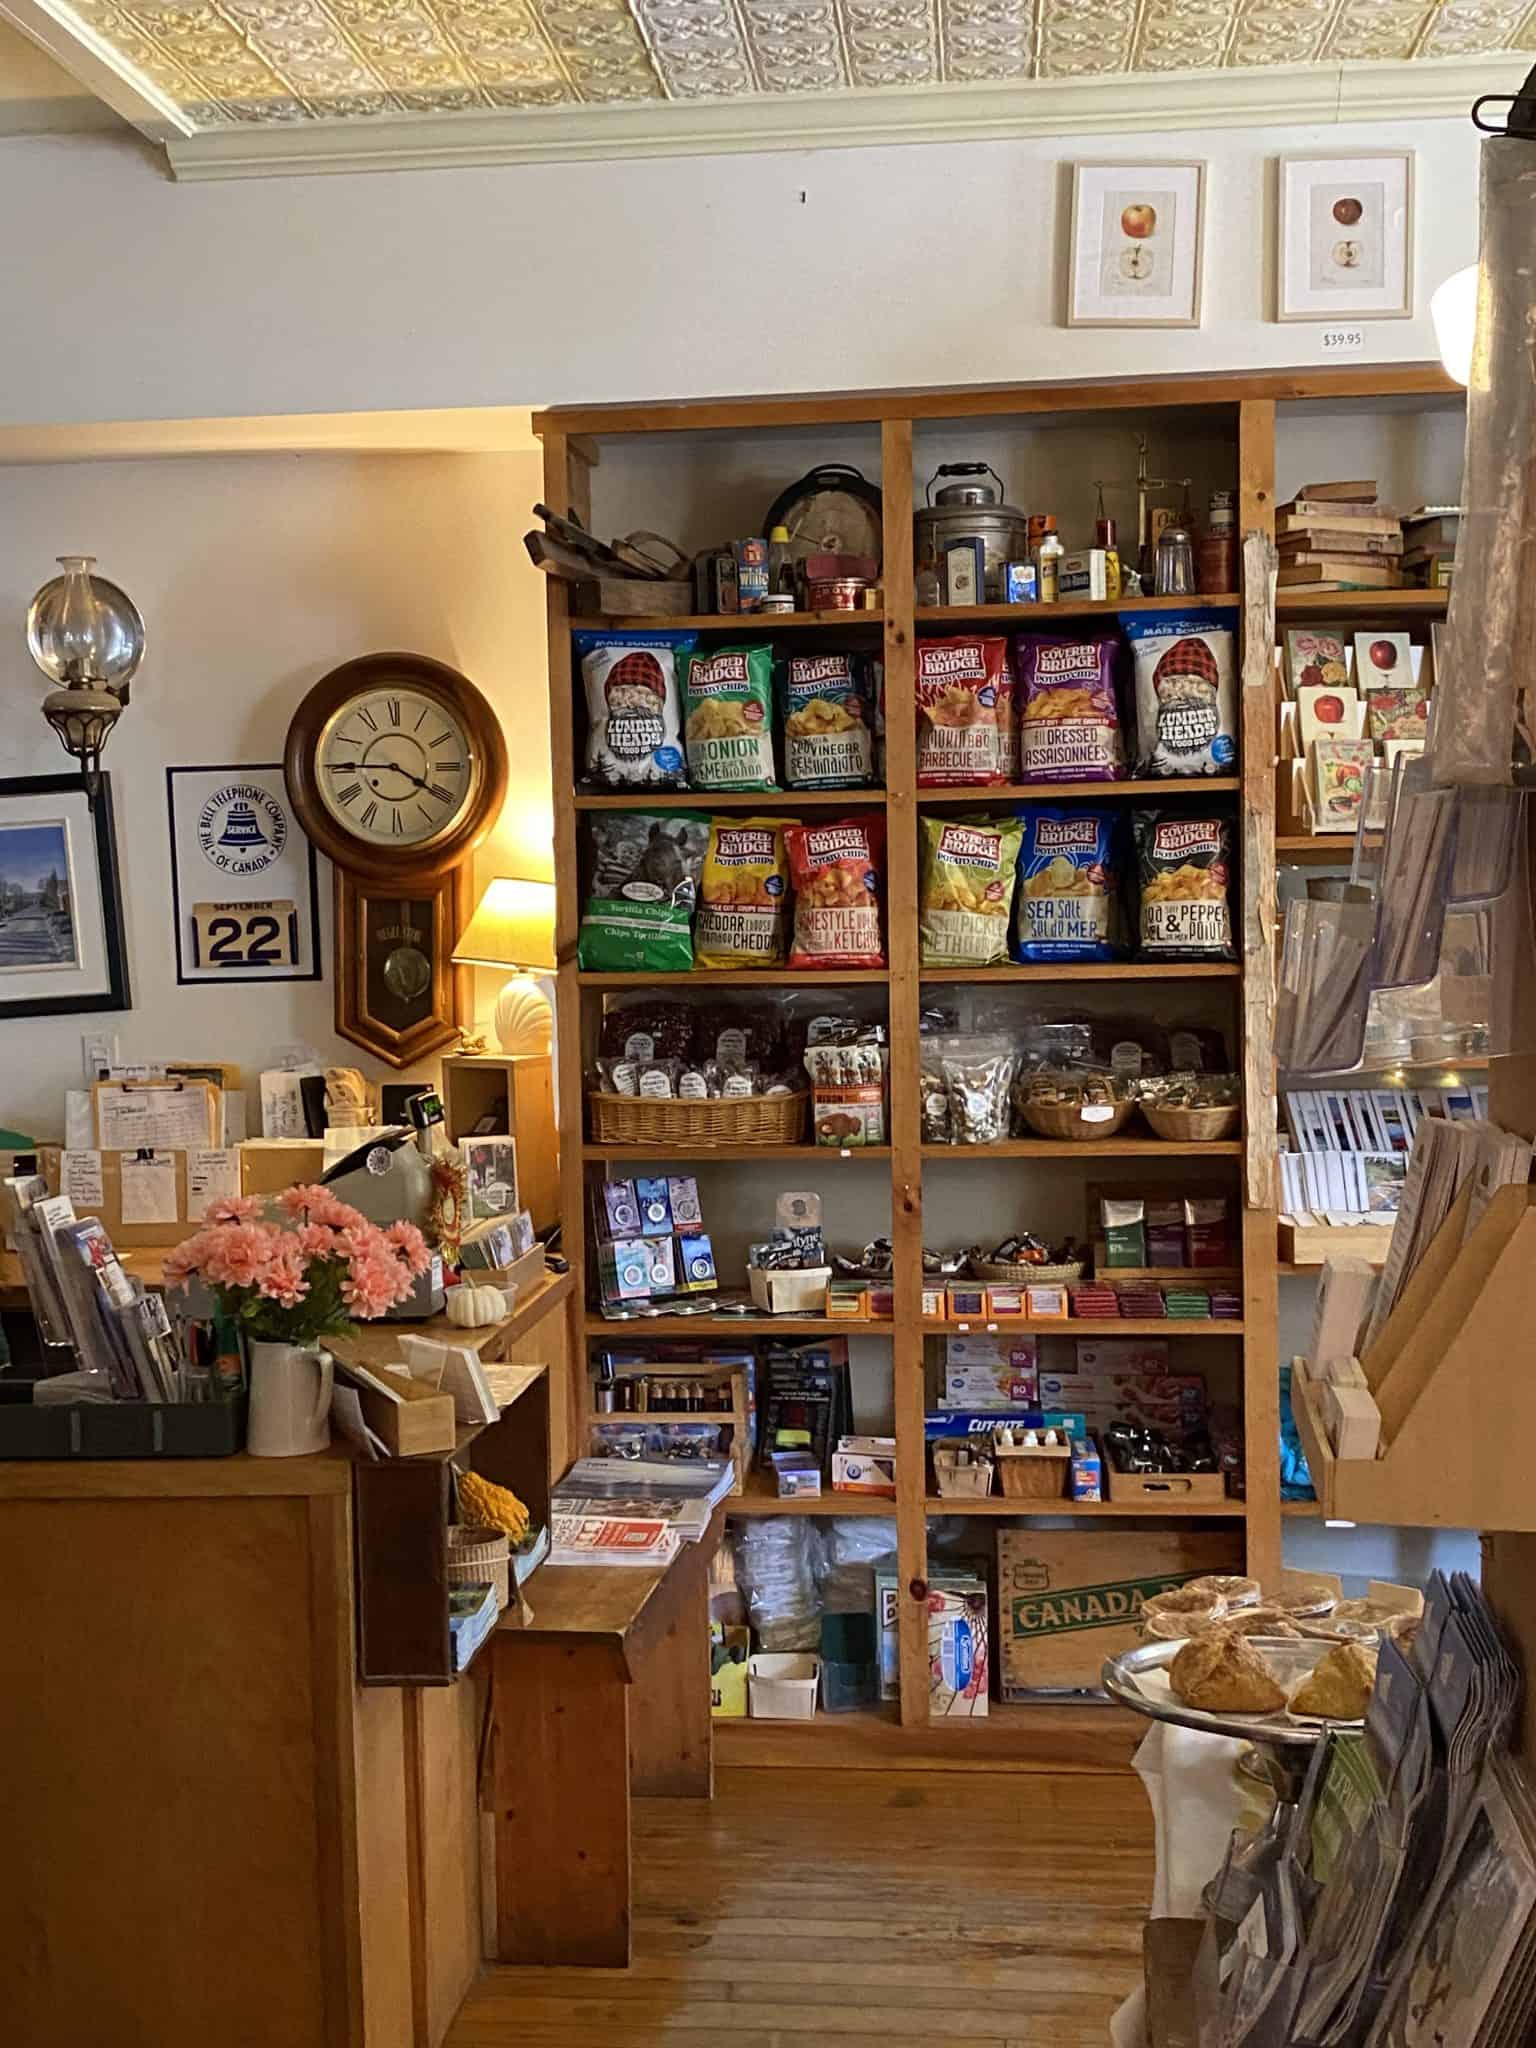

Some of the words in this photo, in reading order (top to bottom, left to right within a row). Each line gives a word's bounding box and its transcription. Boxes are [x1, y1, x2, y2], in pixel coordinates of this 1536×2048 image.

[1324, 333, 1360, 346] $39.95
[924, 648, 978, 661] COVERED
[1041, 645, 1096, 660] COVERED
[925, 657, 980, 675] BRIDGE
[1041, 655, 1097, 672] BRIDGE
[692, 666, 744, 683] BRIDGE
[792, 664, 846, 683] BRIDGE
[608, 719, 663, 733] LUMBER
[1158, 708, 1217, 727] LUMBER
[1047, 728, 1097, 745] DRESSED
[1161, 722, 1216, 740] HEADS
[609, 733, 661, 747] HEADS
[707, 738, 760, 759] ONION
[811, 742, 860, 757] VINEGAR
[1025, 745, 1108, 766] ASSAISONNÉES
[920, 751, 973, 768] BARBECUE
[213, 787, 266, 808] TELEPHONE
[200, 803, 217, 829] BELL
[226, 824, 257, 835] SERVICE
[264, 800, 286, 851] COMPANY
[1041, 822, 1094, 832] COVERED
[1160, 823, 1215, 838] COVERED
[201, 831, 214, 851] THE
[720, 831, 773, 842] COVERED
[808, 829, 862, 842] COVERED
[945, 830, 998, 846] COVERED
[1040, 831, 1094, 844] BRIDGE
[1160, 831, 1215, 849] BRIDGE
[720, 841, 773, 854] BRIDGE
[808, 837, 863, 854] BRIDGE
[943, 838, 996, 857] BRIDGE
[714, 856, 747, 865] POTATO
[748, 856, 774, 865] CHIPS
[841, 850, 868, 860] CHIPS
[937, 852, 972, 865] POTATO
[971, 857, 999, 870] CHIPS
[215, 855, 230, 868] OF
[231, 855, 272, 873] CANADA
[213, 901, 273, 912] SEPTEMBER
[610, 903, 644, 914] Tortilla
[645, 907, 672, 917] Chips
[1027, 901, 1054, 919] SEA
[698, 911, 744, 932] CHEDDAR
[961, 914, 1005, 937] PICKLE
[1067, 920, 1098, 937] MER
[1165, 914, 1181, 932] &
[208, 916, 282, 962] 22
[604, 927, 631, 937] Chips
[967, 1419, 1024, 1432] CUT-RITE
[1019, 1588, 1145, 1629] CANADA
